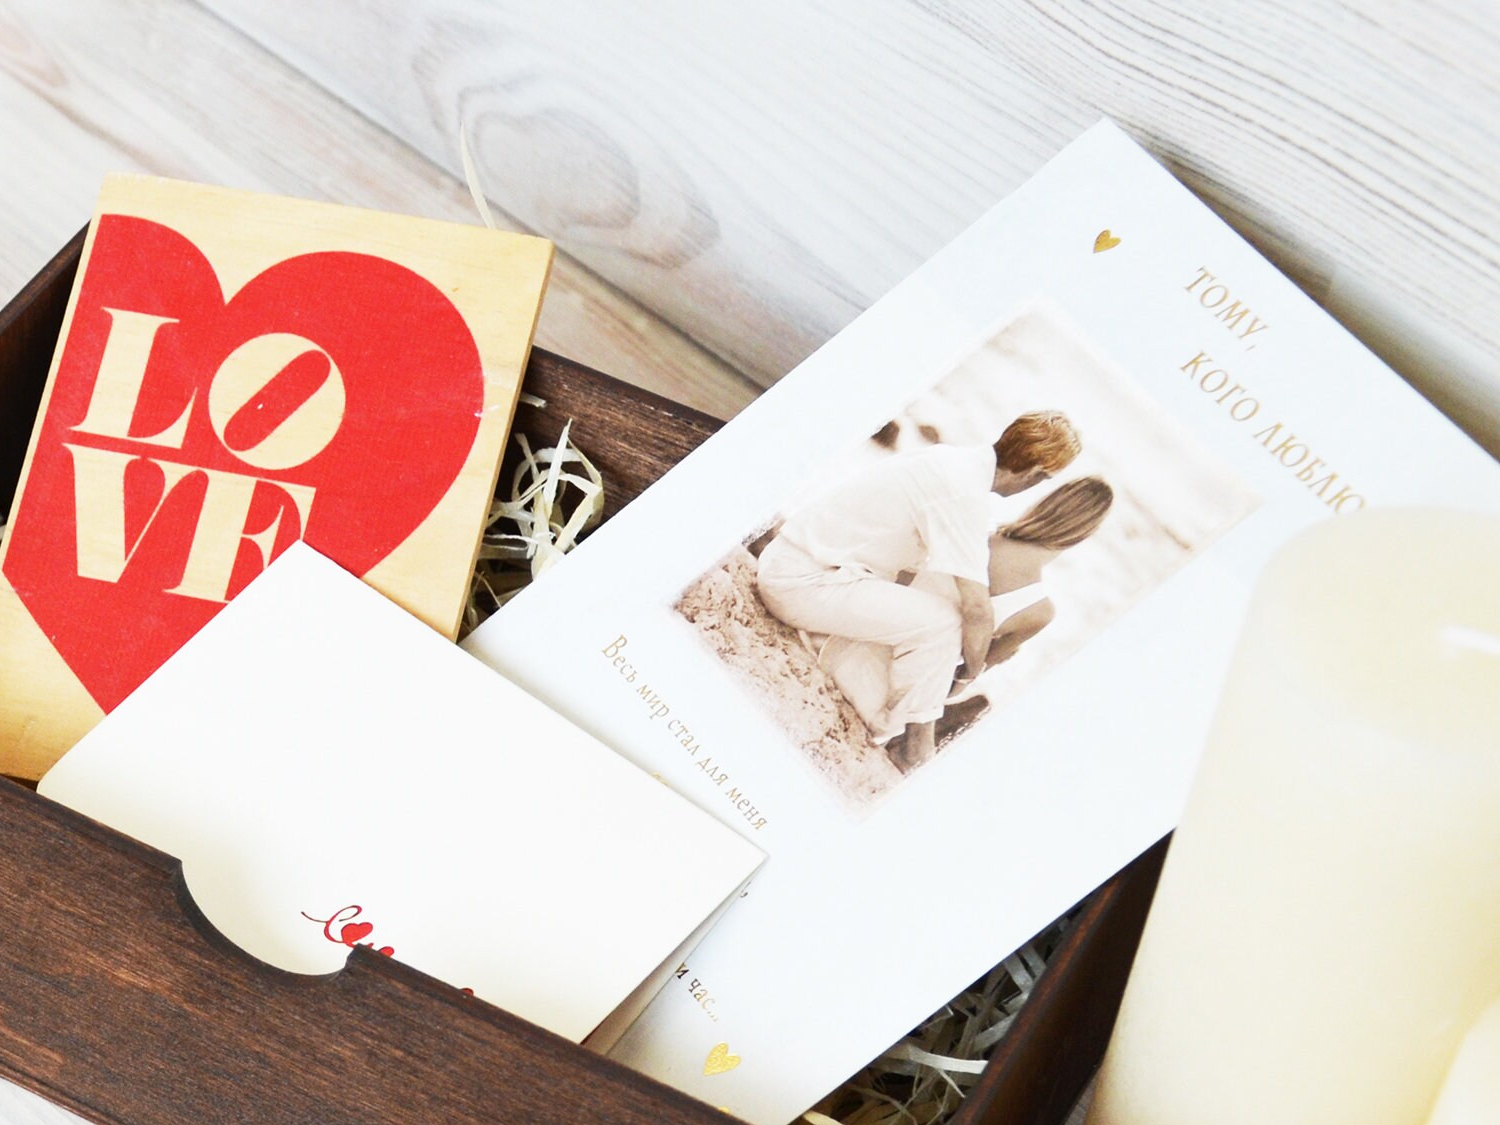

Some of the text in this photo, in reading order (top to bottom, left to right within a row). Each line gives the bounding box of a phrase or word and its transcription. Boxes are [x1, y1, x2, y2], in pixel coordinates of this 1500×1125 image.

[1183, 266, 1270, 351] ТОМУ,
[1180, 350, 1260, 422] КОГО
[601, 634, 768, 831] Весь мир стал для меня
